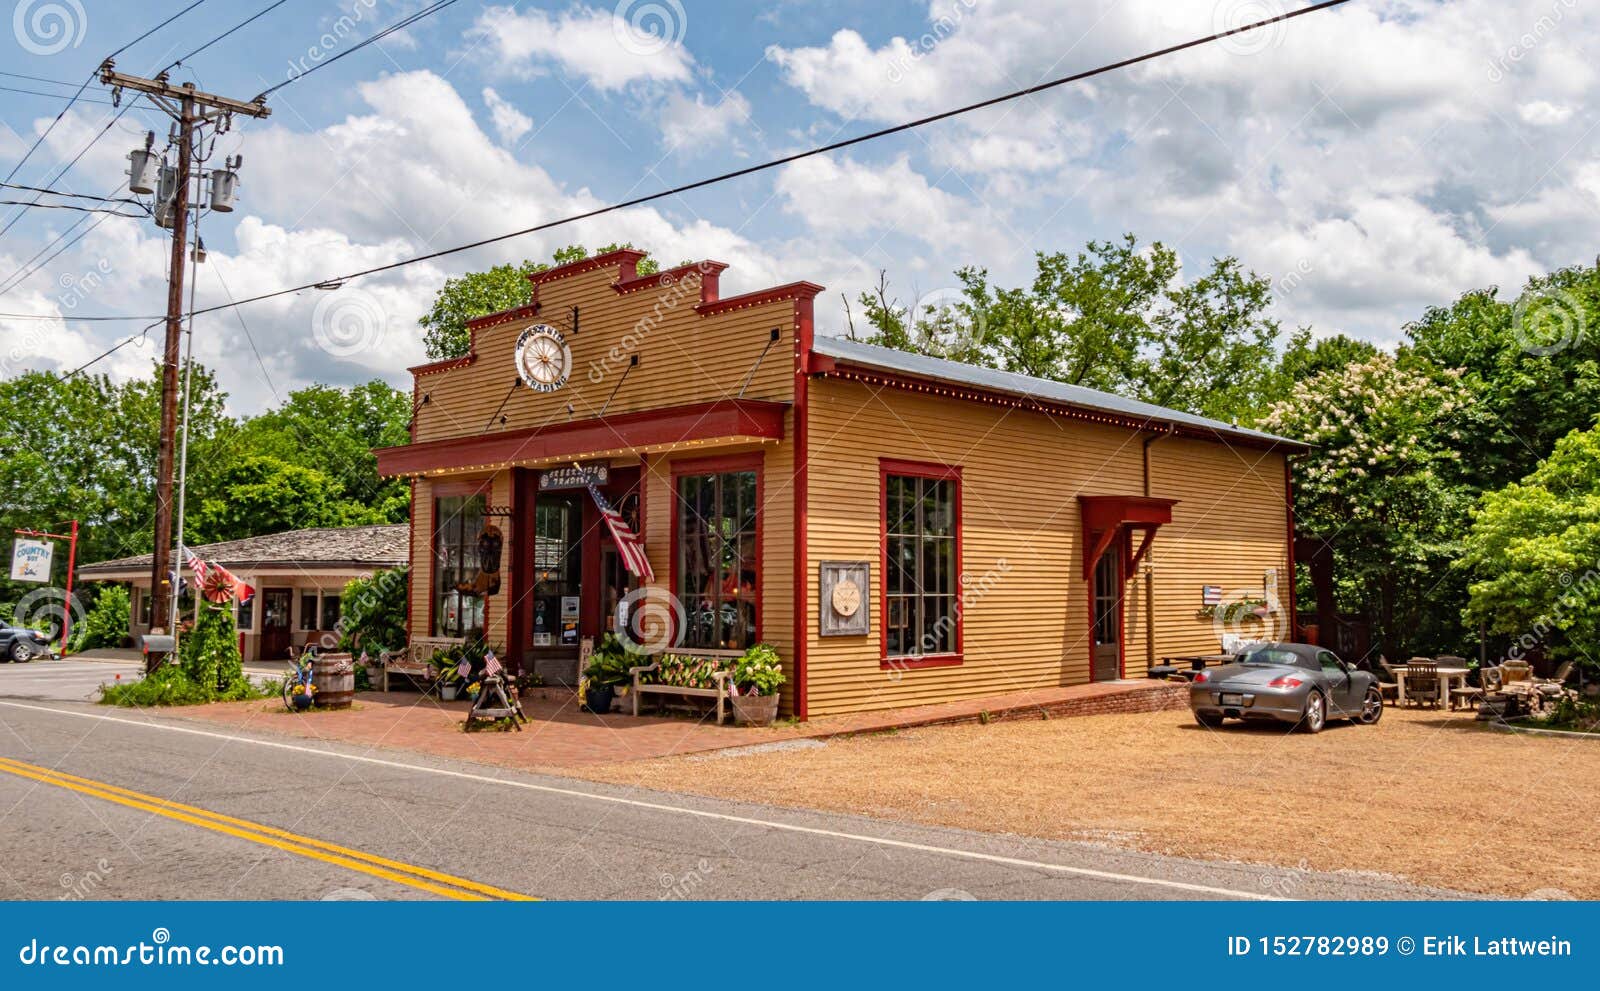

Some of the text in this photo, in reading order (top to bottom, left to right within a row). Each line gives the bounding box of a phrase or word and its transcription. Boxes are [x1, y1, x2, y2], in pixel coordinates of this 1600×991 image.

[525, 375, 567, 392] TRADING
[549, 465, 599, 479] CREEKIDE
[16, 546, 50, 559] COUNTRY
